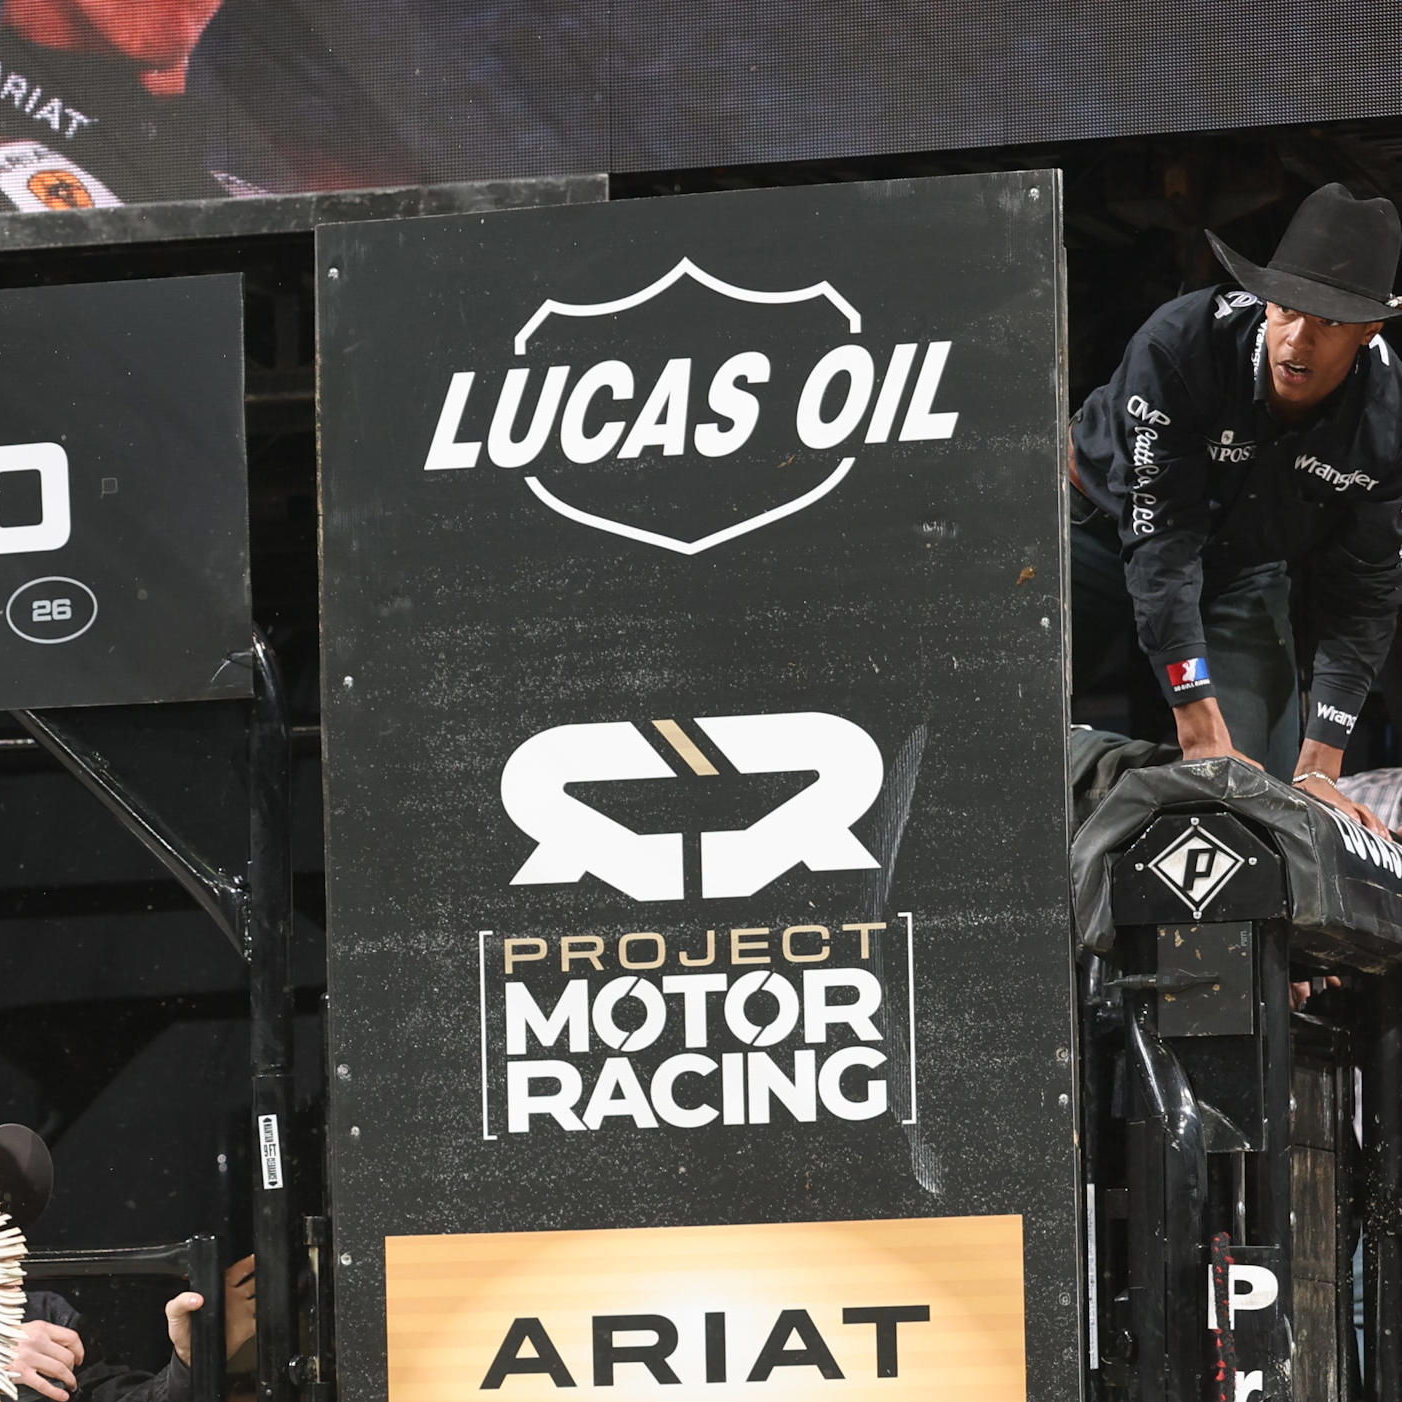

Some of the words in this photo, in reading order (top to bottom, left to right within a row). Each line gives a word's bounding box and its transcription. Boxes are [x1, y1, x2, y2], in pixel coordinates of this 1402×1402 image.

[424, 352, 771, 471] LUCAS
[797, 341, 959, 449] OIL
[1294, 454, 1379, 492] Wrangler
[32, 598, 72, 622] 26
[503, 921, 888, 975] PROJECT
[505, 967, 884, 1054] MOTOR
[507, 1047, 888, 1133] RACING
[480, 1305, 931, 1390] ARIAT
